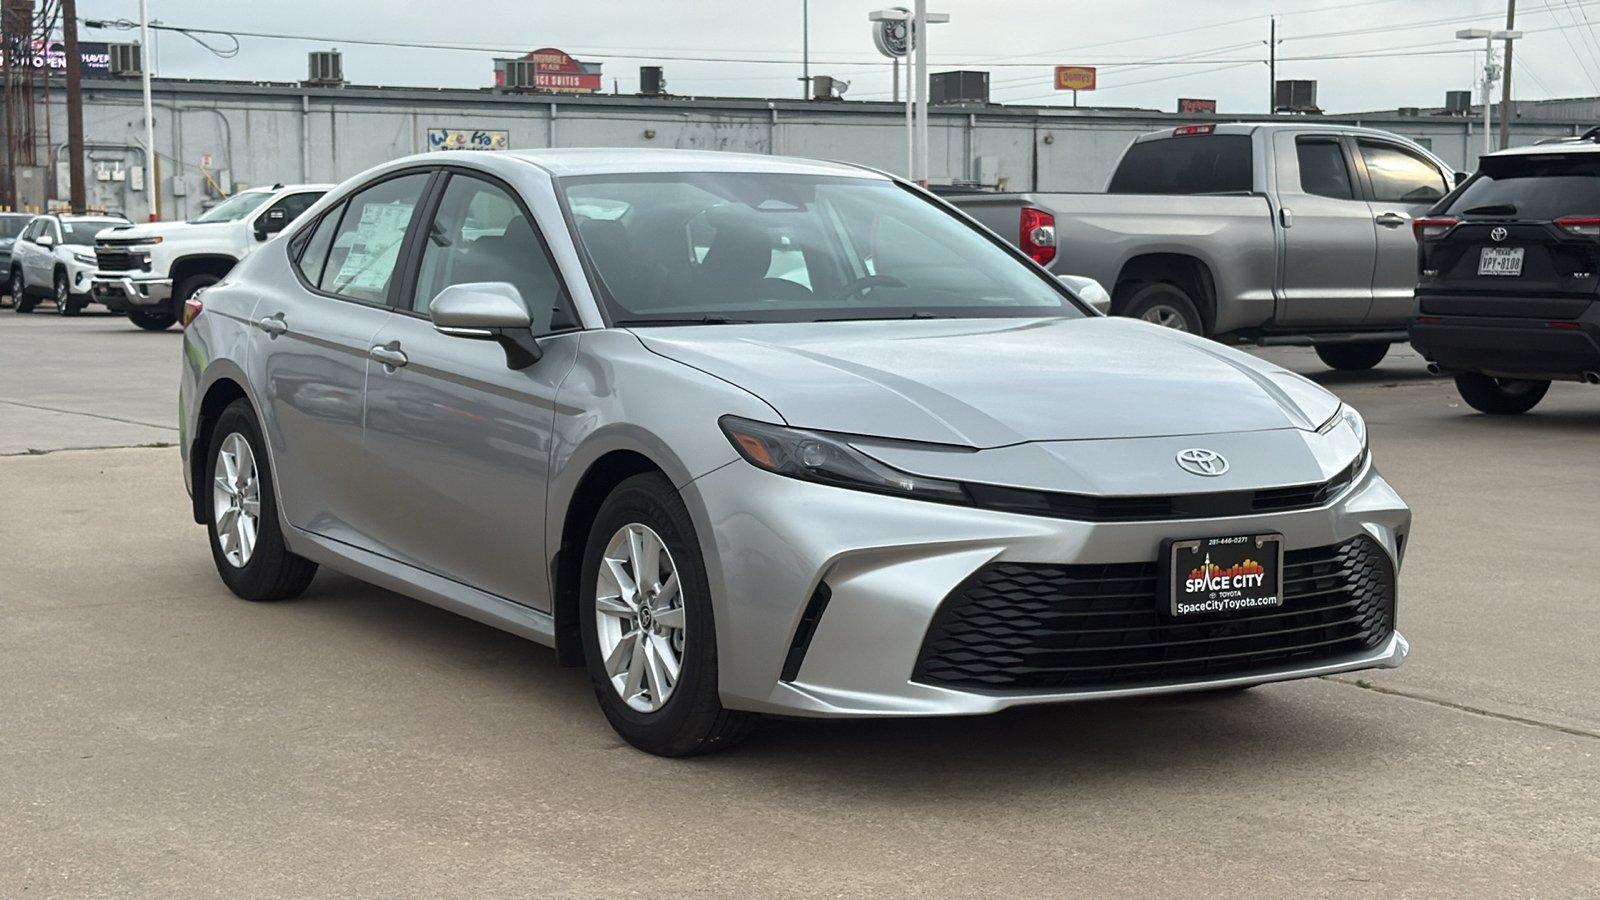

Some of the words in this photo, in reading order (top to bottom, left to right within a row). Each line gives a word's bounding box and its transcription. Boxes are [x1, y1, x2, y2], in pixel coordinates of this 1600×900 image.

[541, 63, 560, 71] PLAZA
[535, 75, 549, 86] ICE
[551, 76, 580, 87] SUITES
[430, 129, 467, 146] Wee
[470, 131, 506, 147] Kare
[1208, 536, 1248, 546] 281-446-0271
[1185, 573, 1230, 593] SPACE
[1232, 573, 1264, 588] CITY
[1219, 590, 1242, 598] TOYOTA
[1177, 596, 1277, 614] SpaceCityToyota.com
